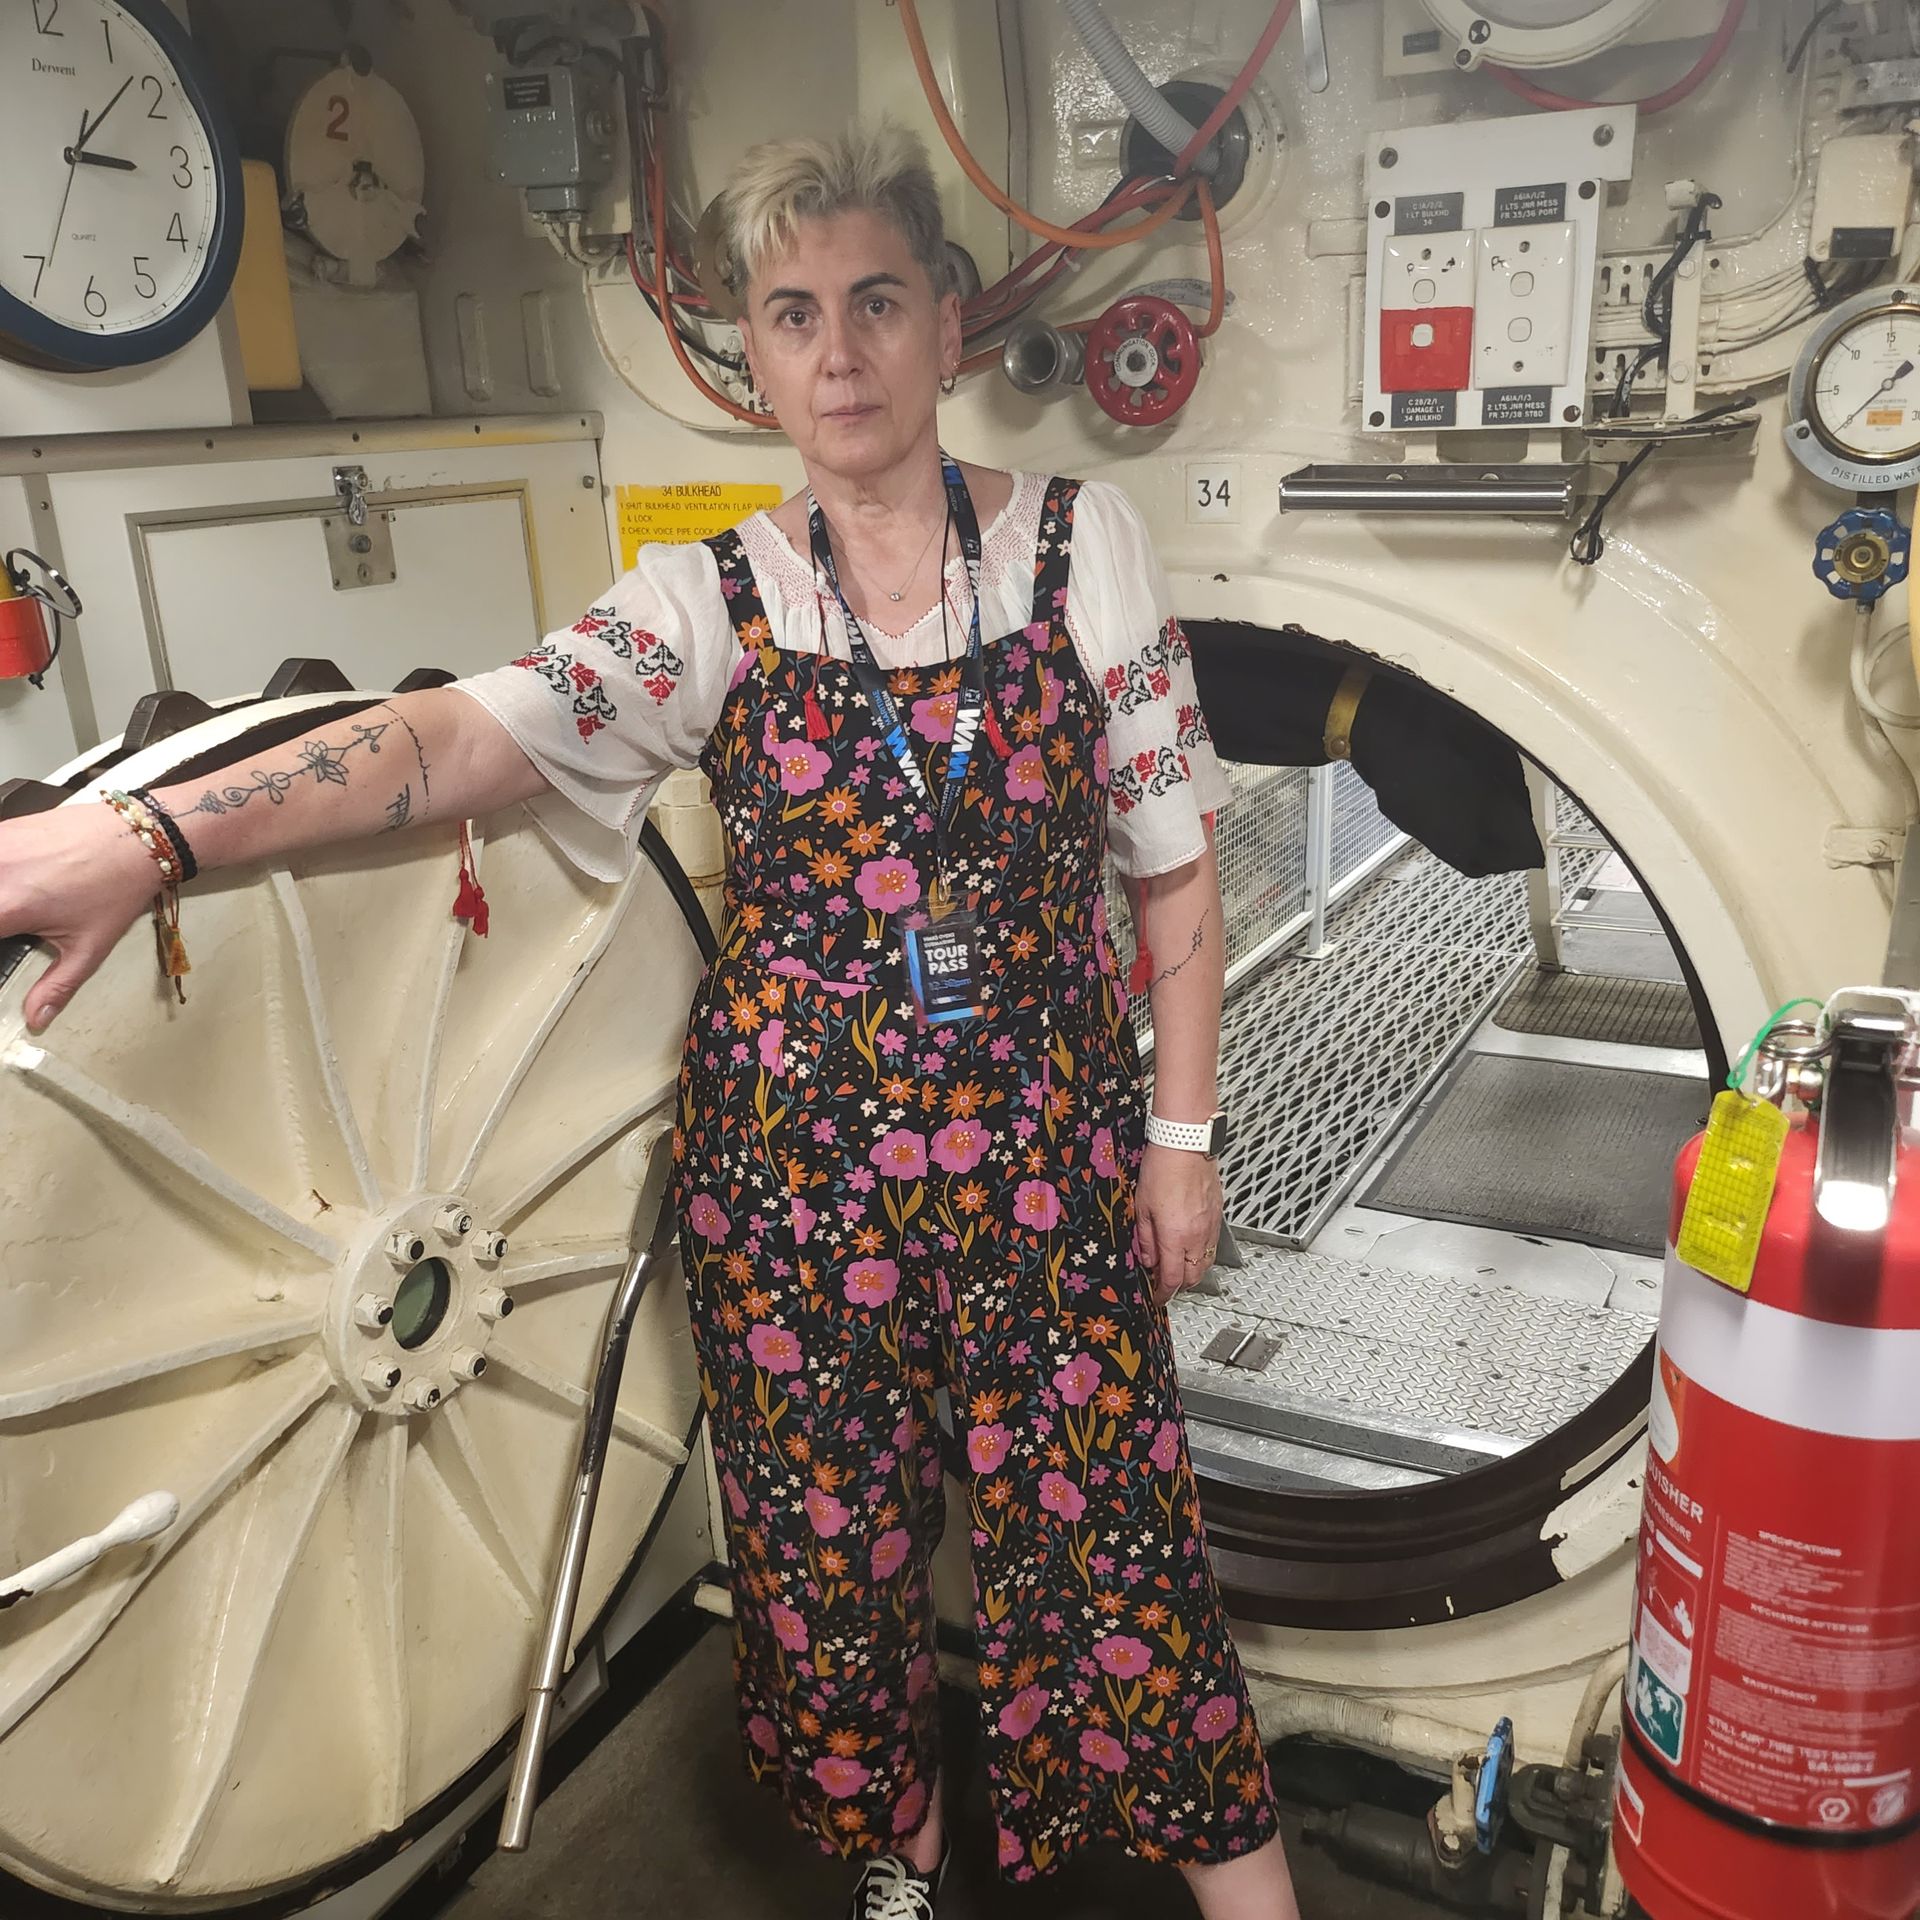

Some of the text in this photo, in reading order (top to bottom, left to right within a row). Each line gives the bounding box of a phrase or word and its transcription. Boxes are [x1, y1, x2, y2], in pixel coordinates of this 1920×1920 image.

[32, 0, 65, 37] 12
[100, 19, 114, 64] 1
[30, 57, 77, 77] Derwent
[141, 75, 168, 120] 2
[326, 94, 350, 142] 2
[169, 145, 193, 189] 3
[1505, 202, 1519, 211] LTS
[1520, 201, 1535, 210] JNR
[1536, 199, 1559, 208] MESS
[1538, 208, 1558, 216] PORT
[1410, 211, 1420, 219] LT
[1422, 219, 1433, 227] 34
[166, 212, 189, 253] 4
[23, 255, 46, 299] 7
[133, 257, 157, 299] 5
[83, 275, 107, 317] 6
[1886, 332, 1897, 343] 15
[1850, 350, 1861, 361] 10
[1833, 385, 1840, 396] 5
[1406, 406, 1435, 414] DAMAGE
[1436, 405, 1445, 413] LT
[1494, 403, 1508, 411] LTS
[1509, 402, 1523, 410] JNR
[1524, 401, 1546, 409] MESS
[1500, 411, 1522, 420] 37/38
[1831, 467, 1890, 484] DISTILLED
[662, 485, 722, 497] 34 BULKHEAD
[1198, 479, 1231, 508] 34
[645, 503, 681, 511] BULKHEAD
[685, 503, 731, 511] VENTILATION
[734, 504, 753, 512] FLAP
[634, 515, 653, 523] LOCK
[628, 527, 649, 535] CHECK
[654, 528, 674, 536] VOICE
[677, 528, 691, 536] PIPE
[694, 528, 714, 536] COCK
[966, 627, 976, 658] MUSEUM
[872, 688, 893, 726] MARITIME
[881, 690, 899, 723] MUSEUM
[876, 715, 885, 731] WA
[940, 782, 951, 817] MUSEUM
[954, 785, 962, 798] WA
[924, 943, 969, 962] TOUR
[928, 957, 969, 976] PASS
